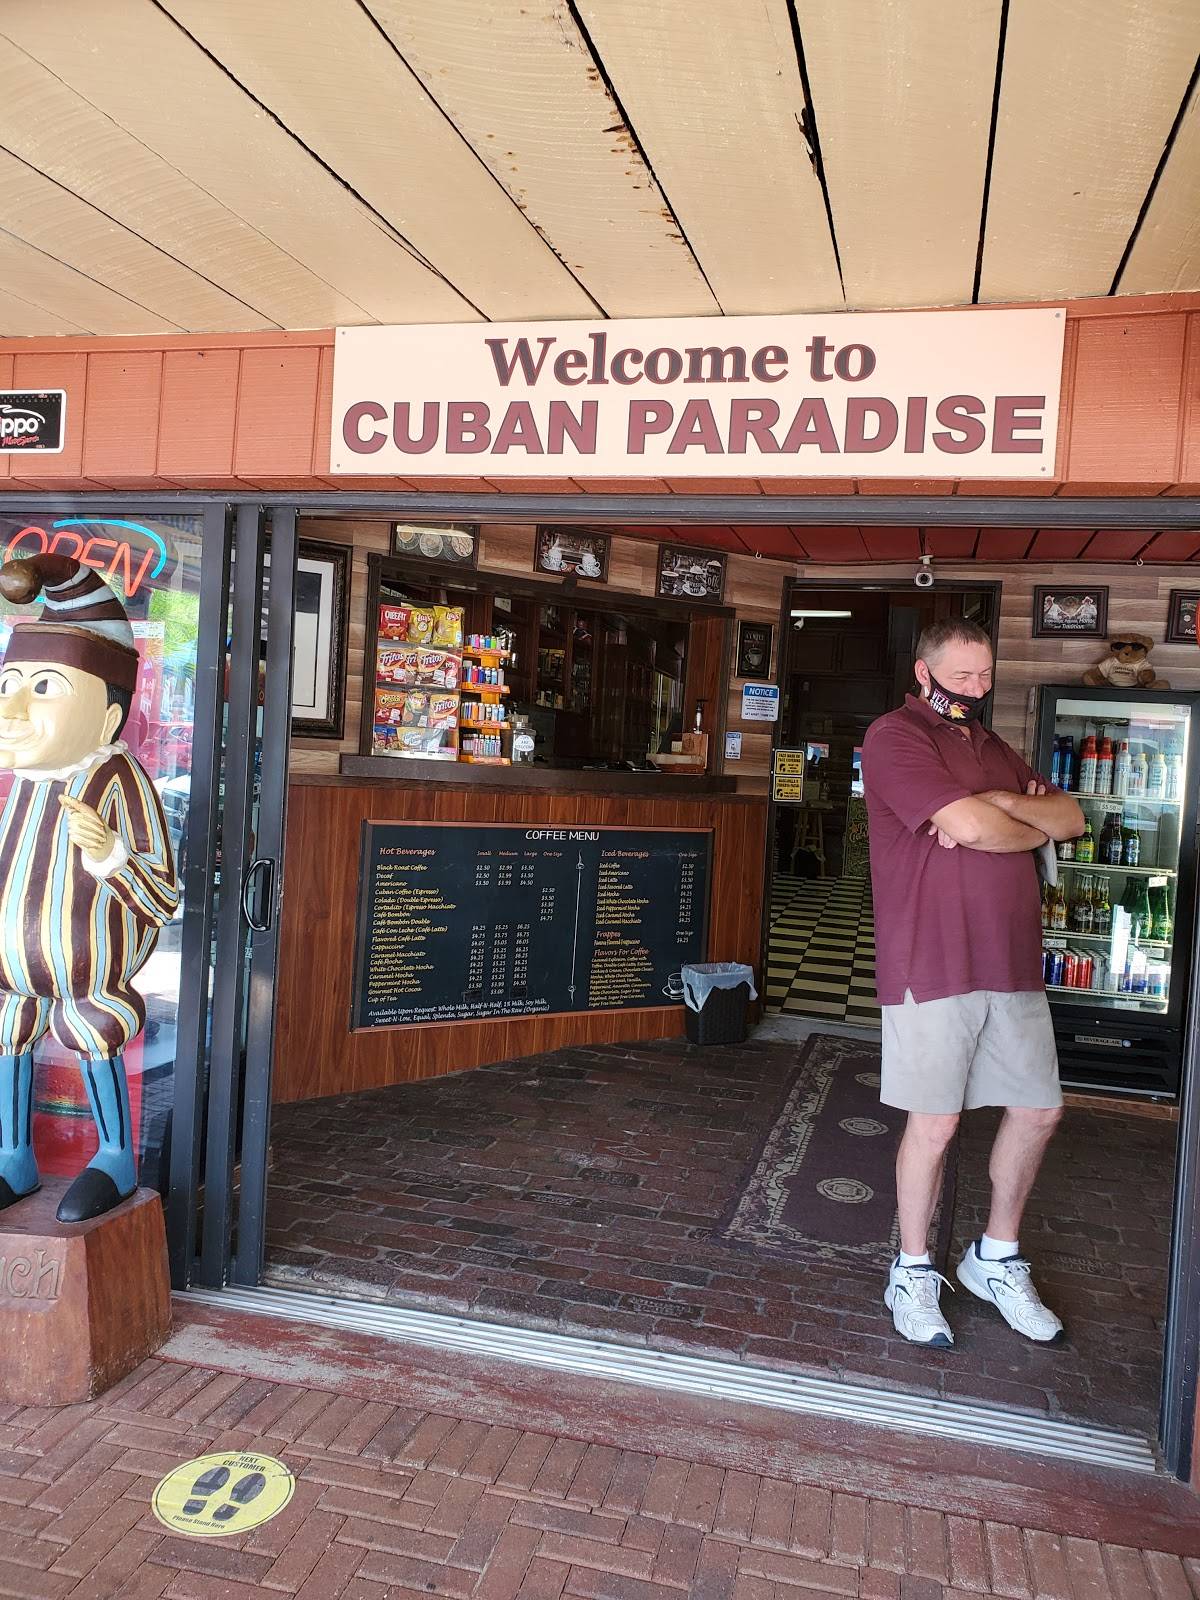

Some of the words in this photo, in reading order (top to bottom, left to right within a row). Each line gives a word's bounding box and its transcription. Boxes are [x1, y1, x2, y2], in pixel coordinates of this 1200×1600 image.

[484, 332, 788, 386] Welcome
[805, 336, 876, 382] to
[0, 417, 38, 437] ppo
[342, 400, 599, 454] CUBAN
[626, 394, 1046, 454] PARADISE
[4, 526, 154, 597] OPEN
[381, 652, 404, 666] Fritos
[421, 654, 443, 664] Fritos
[749, 688, 774, 696] NOTICE
[434, 700, 455, 712] Fritos
[526, 830, 566, 840] COFFEE
[568, 831, 600, 840] MENU
[396, 848, 436, 857] Beverages
[617, 850, 649, 859] Beverages
[630, 947, 649, 956] Coffee
[523, 1005, 550, 1013] (Organic)
[239, 1455, 259, 1464] NEXT
[222, 1460, 266, 1472] CUSTOMER
[172, 1515, 194, 1523] Please
[194, 1518, 211, 1527] Stand
